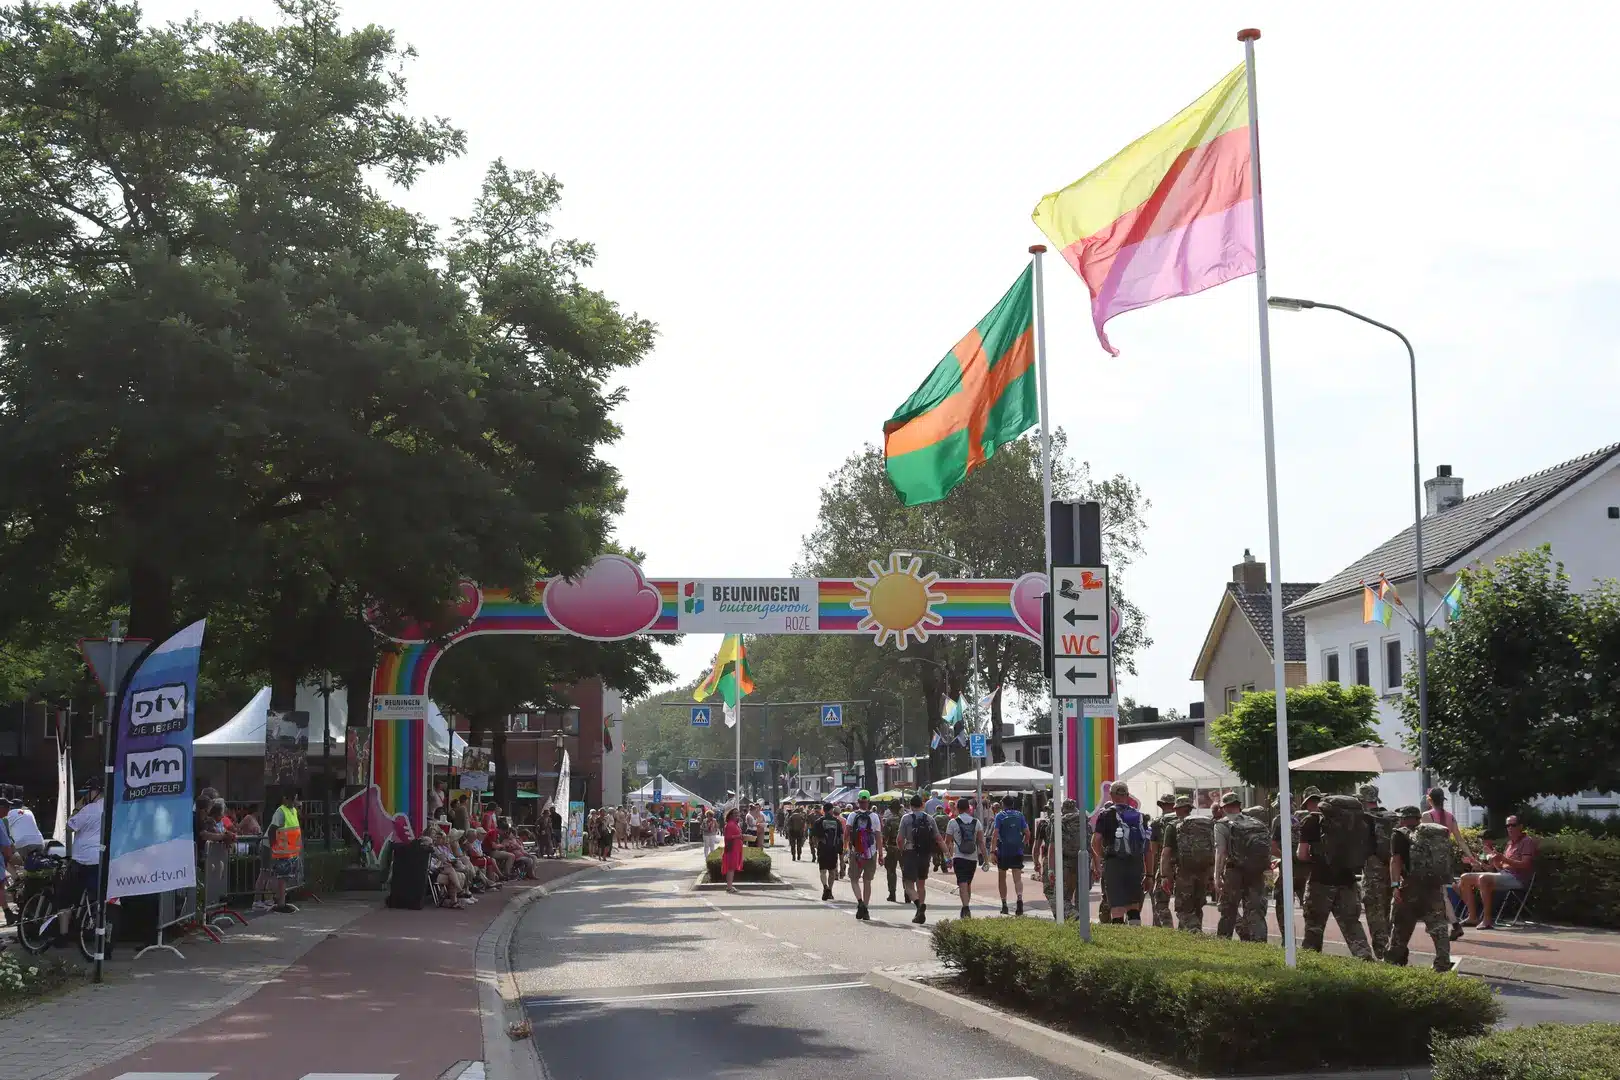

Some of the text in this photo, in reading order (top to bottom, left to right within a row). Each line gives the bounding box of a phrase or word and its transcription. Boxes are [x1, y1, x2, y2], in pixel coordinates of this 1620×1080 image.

[712, 586, 800, 601] BEUNINGEN
[719, 600, 811, 619] buitengewoon
[785, 616, 811, 630] ROZE
[1061, 634, 1100, 655] WC
[116, 866, 187, 887] www.d-tv.nl
